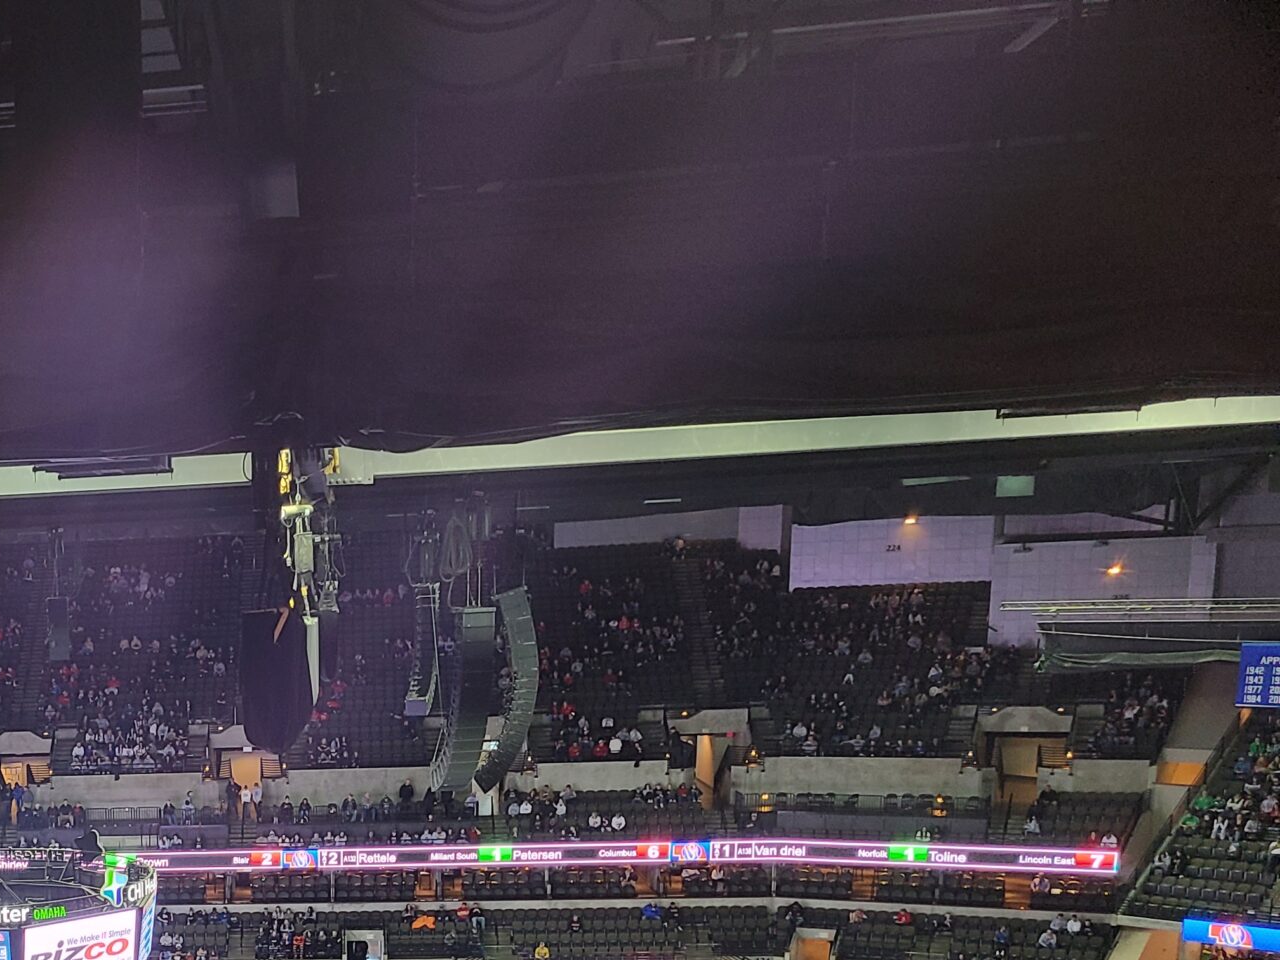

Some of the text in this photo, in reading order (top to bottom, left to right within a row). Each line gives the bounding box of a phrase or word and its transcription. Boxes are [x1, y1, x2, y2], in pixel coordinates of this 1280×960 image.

[1245, 666, 1265, 675] 1942
[1243, 686, 1262, 694] 1977
[232, 856, 249, 865] Blair
[261, 853, 273, 865] 2
[328, 853, 338, 864] 2
[358, 853, 396, 864] Rettele
[430, 851, 455, 861] Millard
[456, 852, 478, 861] South
[512, 849, 562, 861] Petersen
[598, 848, 637, 858] Columbus
[647, 845, 659, 858] 6
[722, 844, 730, 857] 1
[754, 845, 778, 856] Van
[780, 845, 806, 856] driel
[857, 849, 888, 859] Norfolk
[904, 848, 915, 861] 1
[929, 850, 967, 863] Toline
[1018, 855, 1052, 865] Lincoln
[1053, 856, 1076, 866] East
[1090, 854, 1104, 868] 7
[32, 906, 67, 920] OMAHA
[79, 935, 99, 944] Make
[101, 931, 107, 939] IT
[108, 928, 132, 938] Simple
